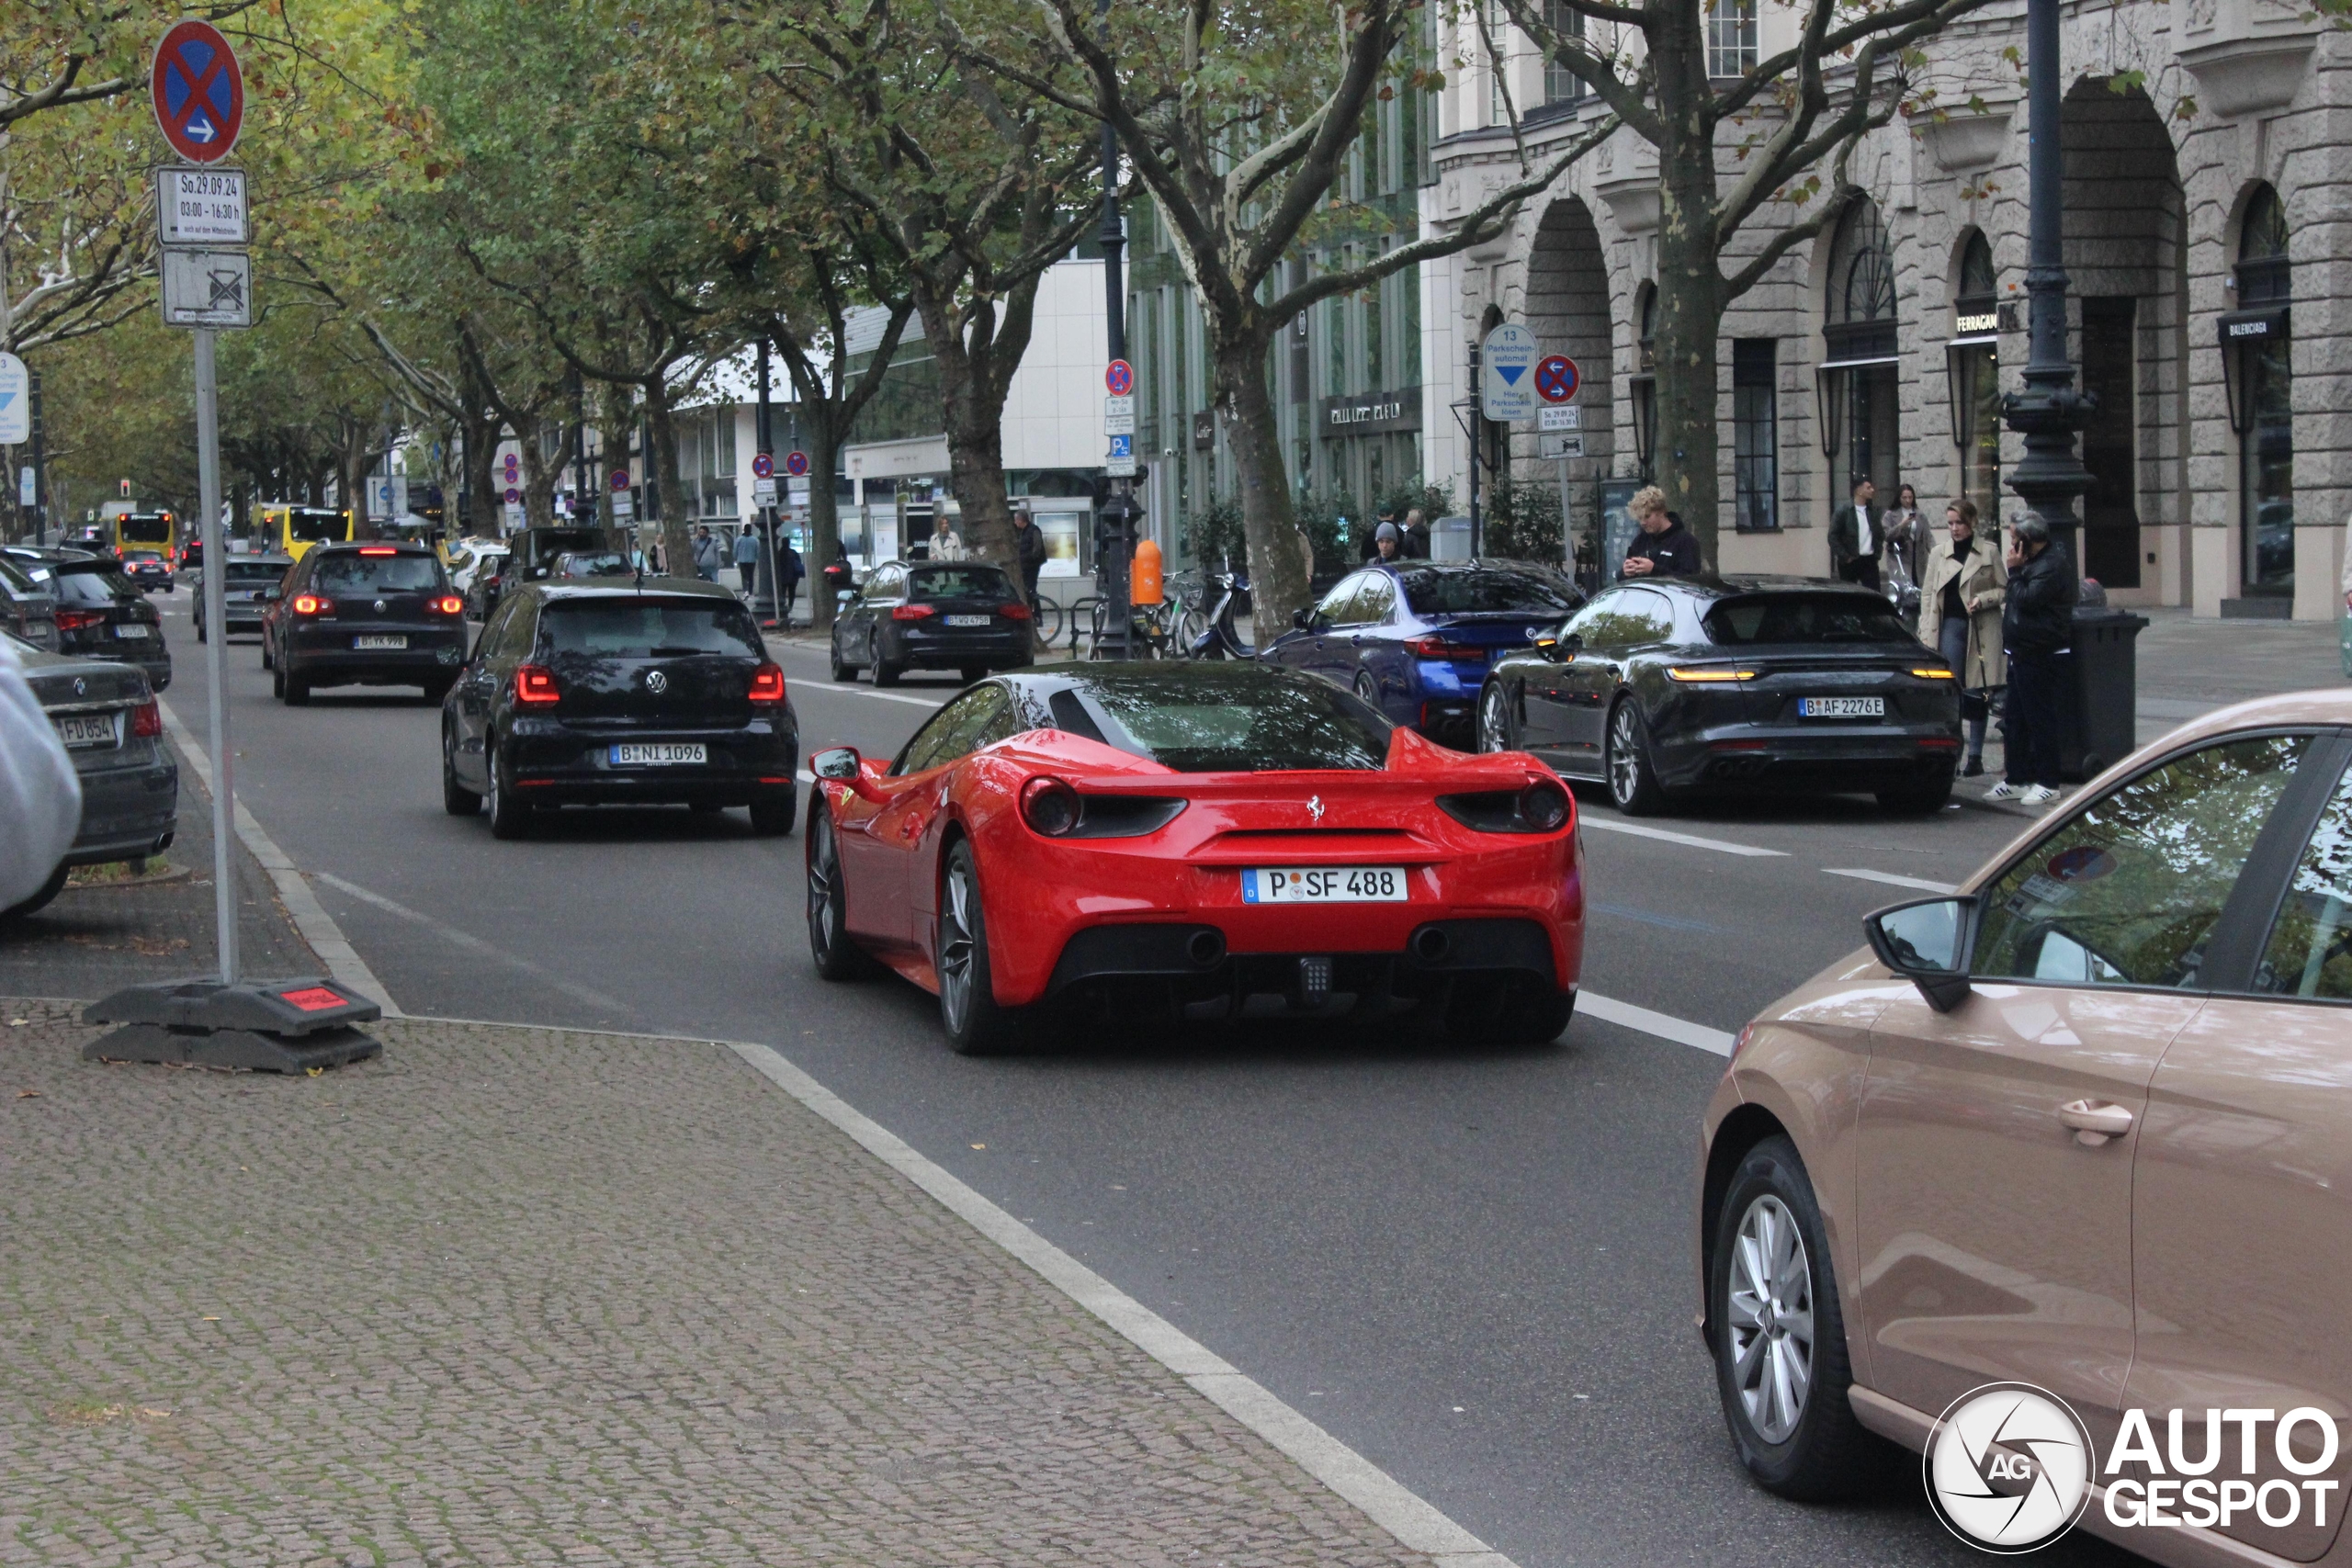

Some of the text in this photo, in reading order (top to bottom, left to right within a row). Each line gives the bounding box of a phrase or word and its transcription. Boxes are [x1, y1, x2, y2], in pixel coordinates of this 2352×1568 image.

[181, 175, 237, 197] So.29.09.24
[180, 201, 202, 218] 03:00
[211, 203, 232, 220] 16:30
[234, 205, 240, 220] h
[1957, 313, 1997, 332] FERRAGAM
[2229, 321, 2267, 337] BALENCIAGA
[1503, 331, 1517, 341] 13
[1487, 344, 1535, 353] Parkschein-
[0, 359, 7, 368] 3
[1374, 402, 1400, 421] PLEIN
[1806, 700, 1815, 714] B
[1825, 700, 1839, 714] AF
[64, 717, 110, 739] FD 854
[621, 746, 632, 761] B
[642, 745, 662, 761] NI
[664, 745, 704, 761] 1096
[1269, 872, 1286, 897] P
[1306, 872, 1339, 897] SF
[1346, 871, 1395, 897] 488
